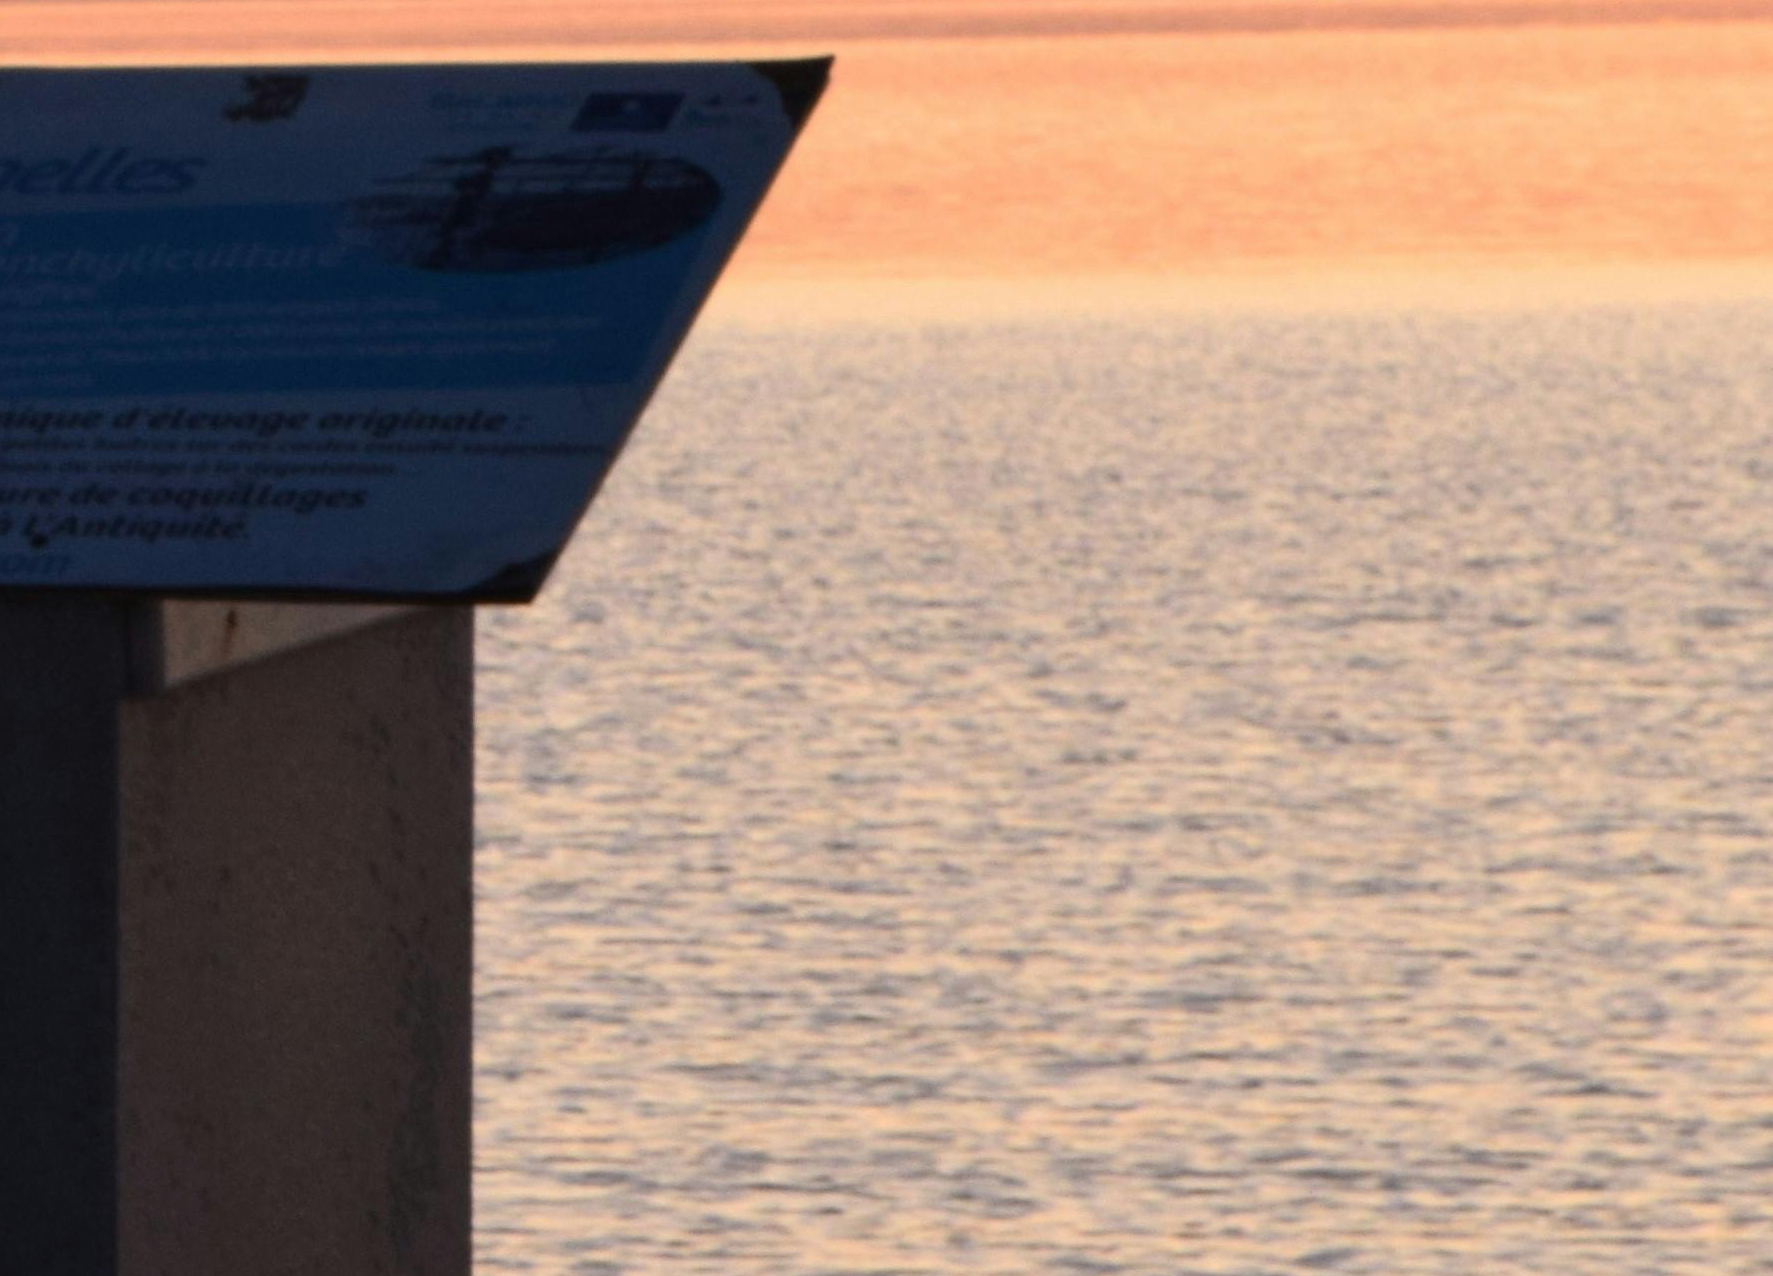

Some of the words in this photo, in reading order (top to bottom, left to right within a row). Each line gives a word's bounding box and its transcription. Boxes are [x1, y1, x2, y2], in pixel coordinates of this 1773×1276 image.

[111, 405, 311, 438] d'élevage
[316, 407, 510, 439] originale
[68, 483, 120, 507] de
[127, 484, 368, 514] coquillages
